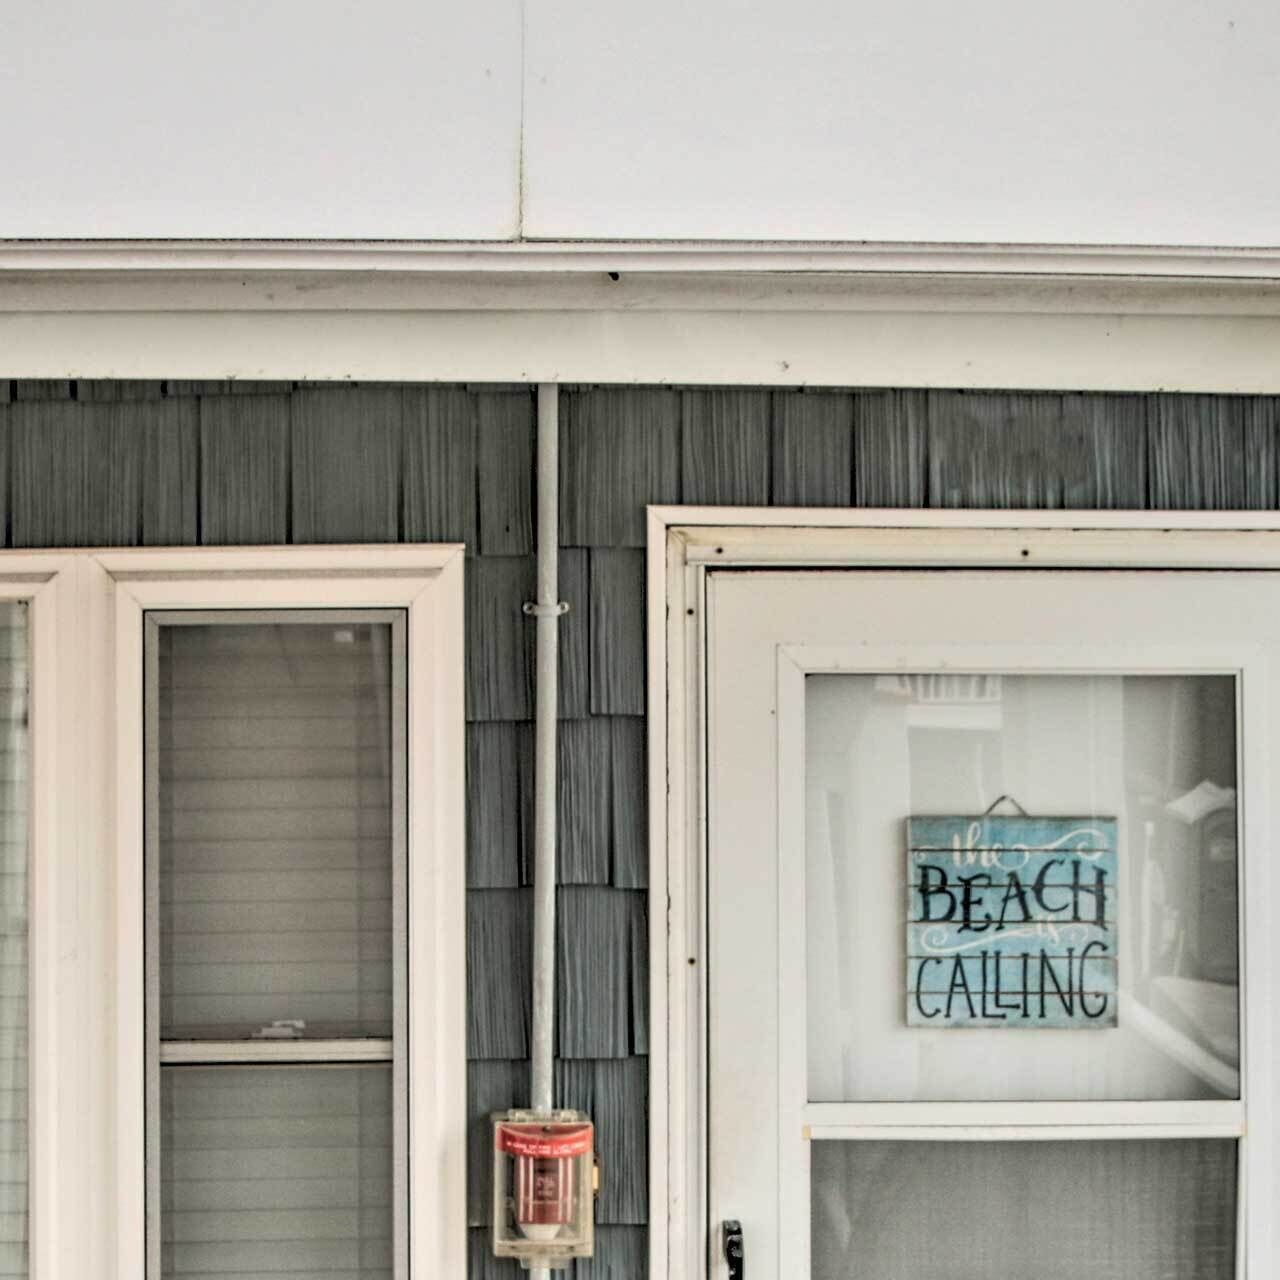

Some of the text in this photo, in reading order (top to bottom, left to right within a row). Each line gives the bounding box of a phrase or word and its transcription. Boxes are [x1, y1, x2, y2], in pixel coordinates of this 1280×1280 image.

[951, 822, 1024, 869] the
[917, 859, 1109, 934] BEACH
[1034, 913, 1061, 946] is
[916, 941, 1109, 1019] CALLING
